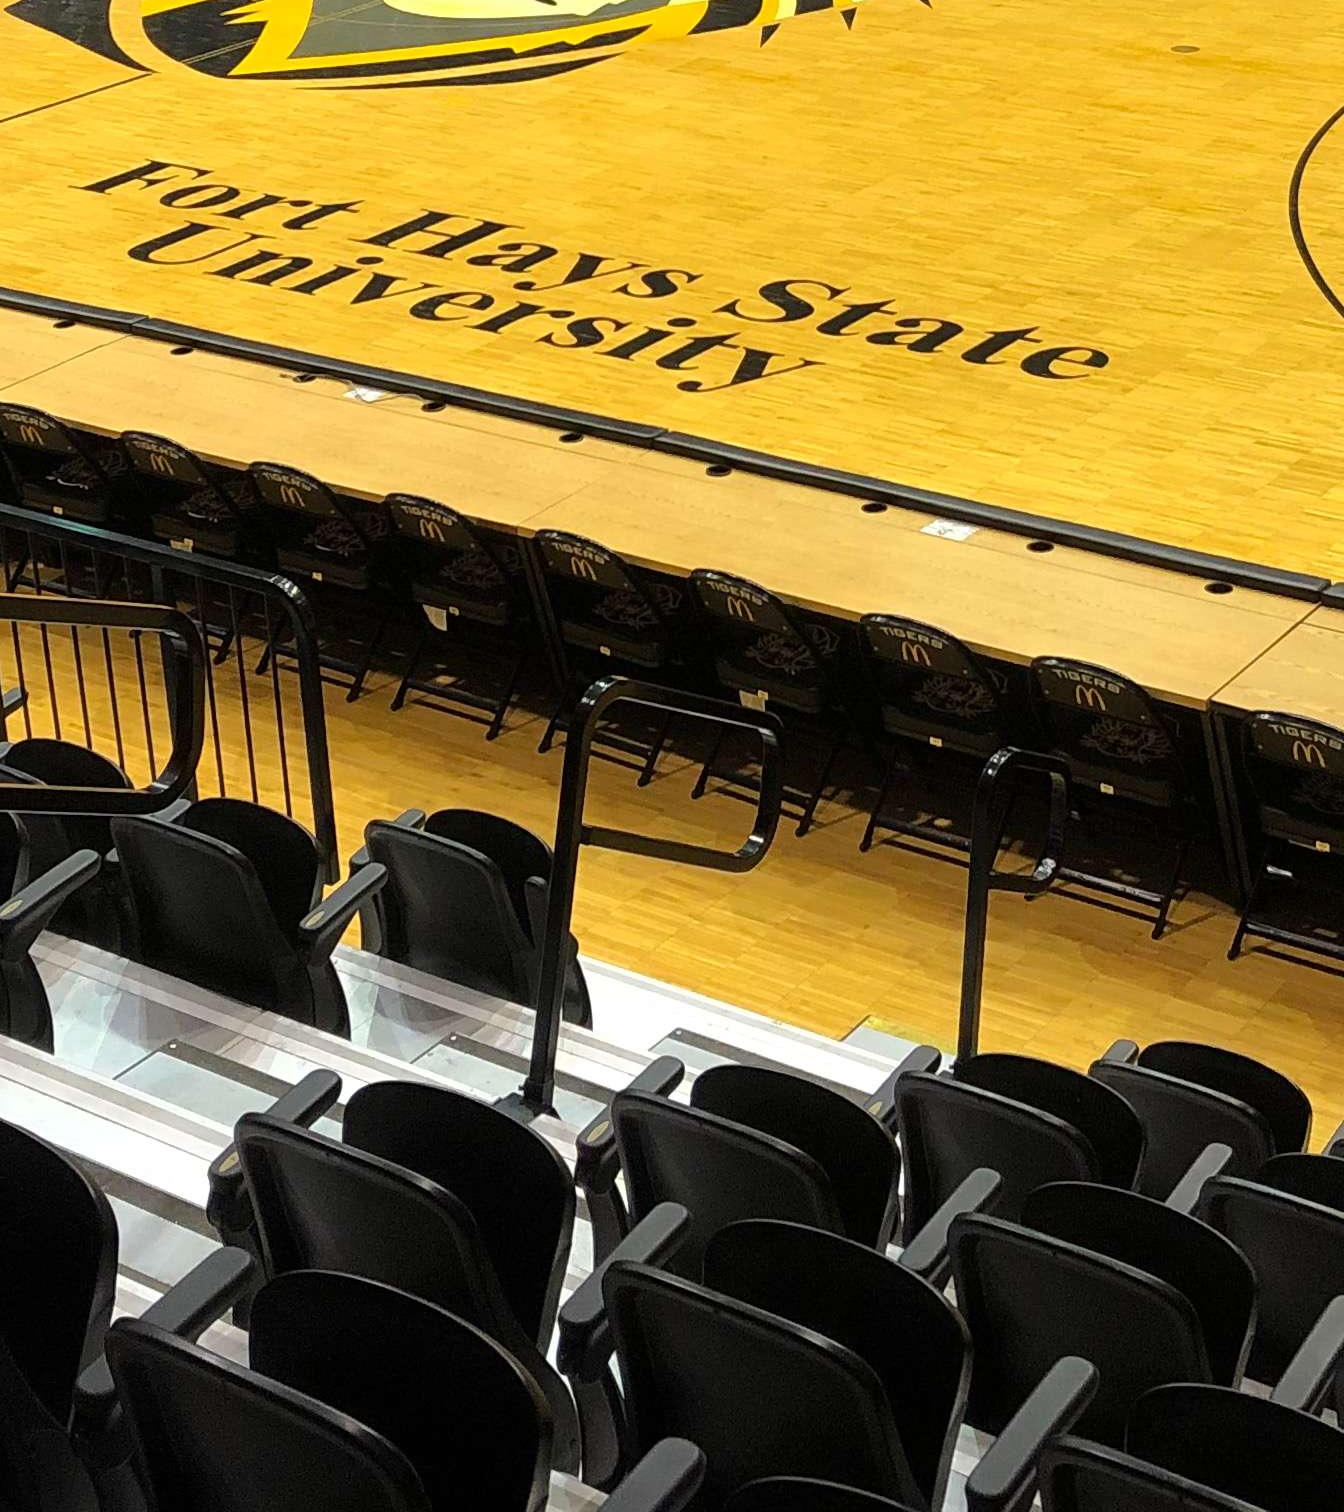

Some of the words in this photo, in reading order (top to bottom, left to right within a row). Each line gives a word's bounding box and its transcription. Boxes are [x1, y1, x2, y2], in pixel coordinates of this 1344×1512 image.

[71, 159, 362, 231] Fort
[353, 208, 698, 299] Hays
[716, 278, 1109, 382] State
[128, 220, 822, 393] University
[707, 579, 765, 606] TIGERS
[880, 625, 948, 651] TIGERS
[1051, 667, 1121, 693] TIGERS
[1267, 721, 1344, 751] TIGERS
